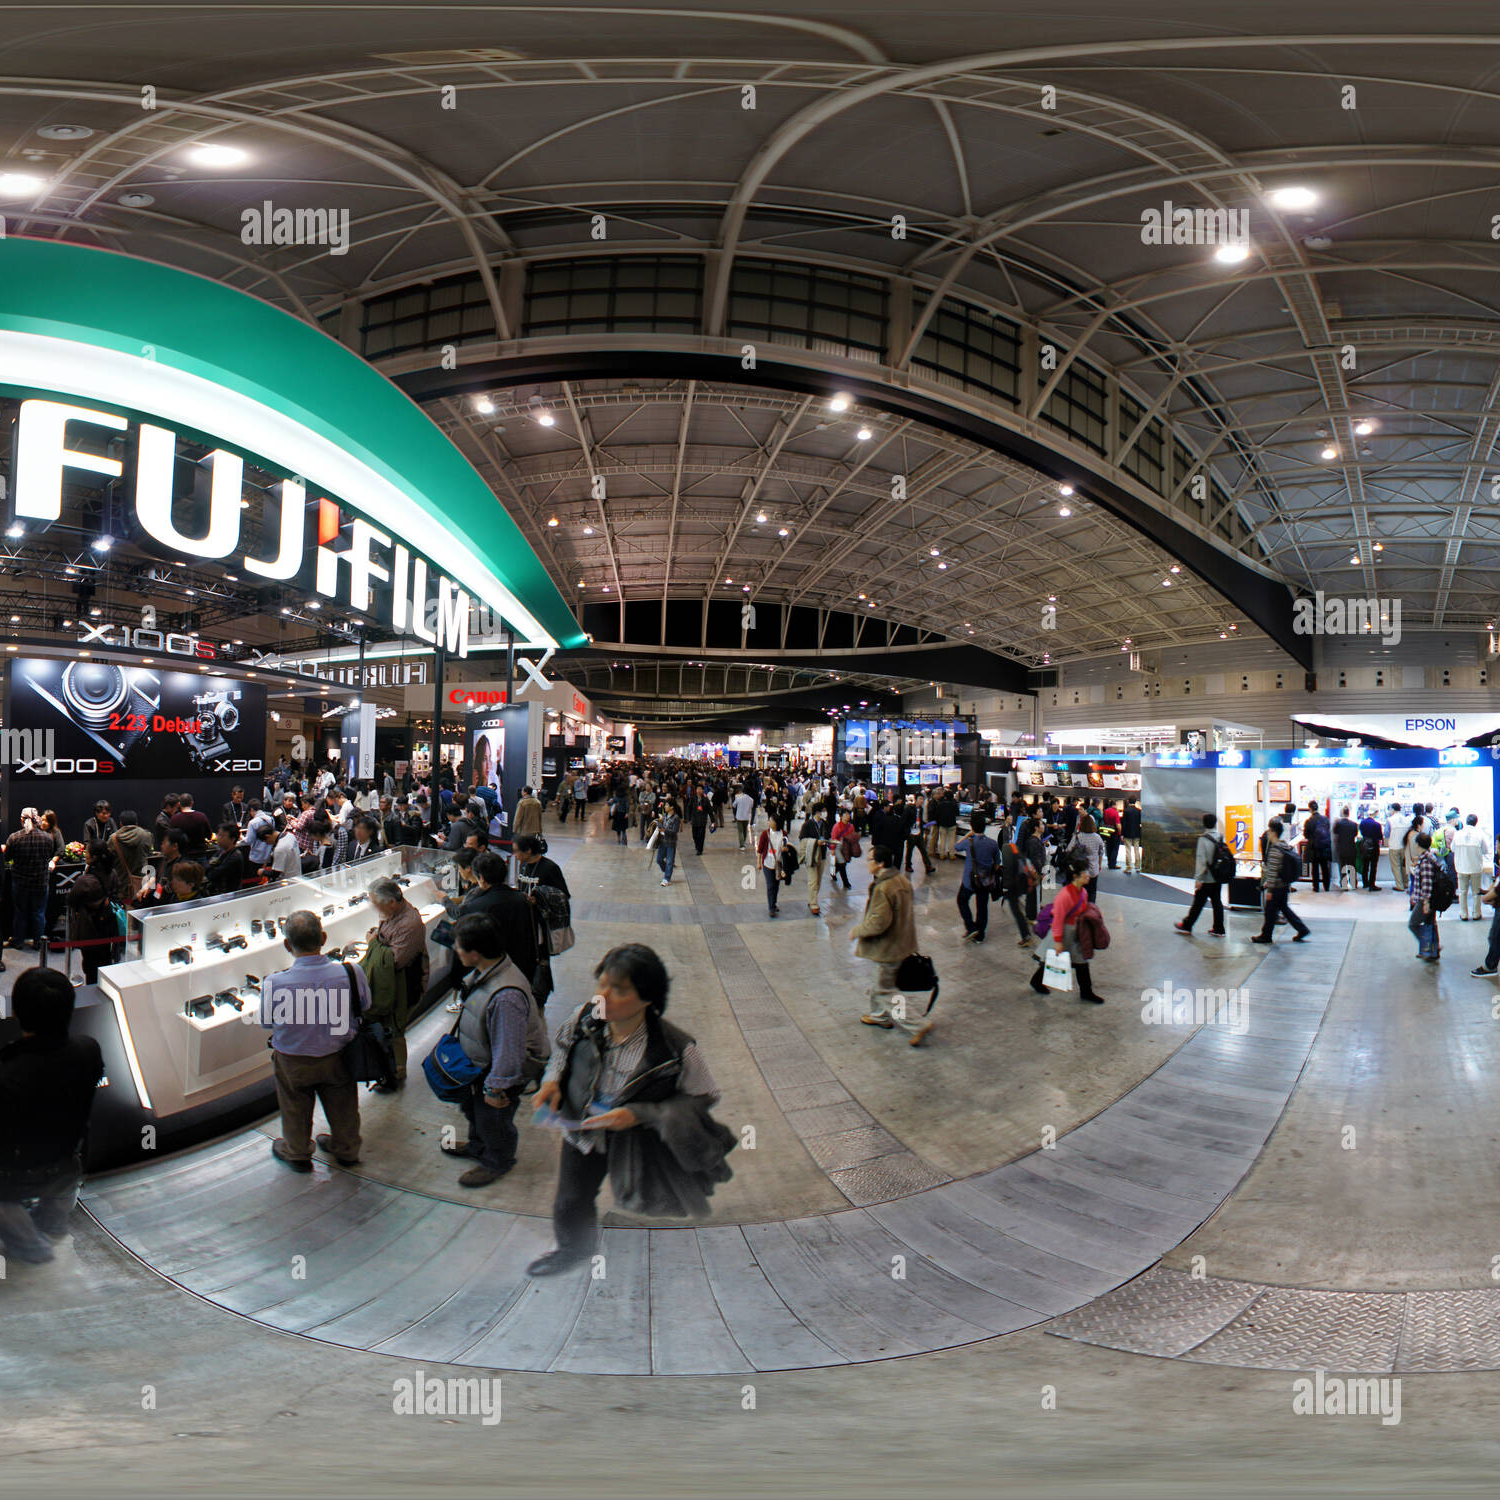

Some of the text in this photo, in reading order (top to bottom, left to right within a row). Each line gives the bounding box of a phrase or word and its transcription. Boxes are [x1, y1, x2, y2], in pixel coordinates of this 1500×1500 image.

[14, 399, 470, 659] FUJIFILM
[109, 713, 203, 734] 2.23 Debut
[1405, 719, 1456, 731] EPSON
[213, 758, 263, 772] X20
[160, 921, 191, 932] X-Pro1
